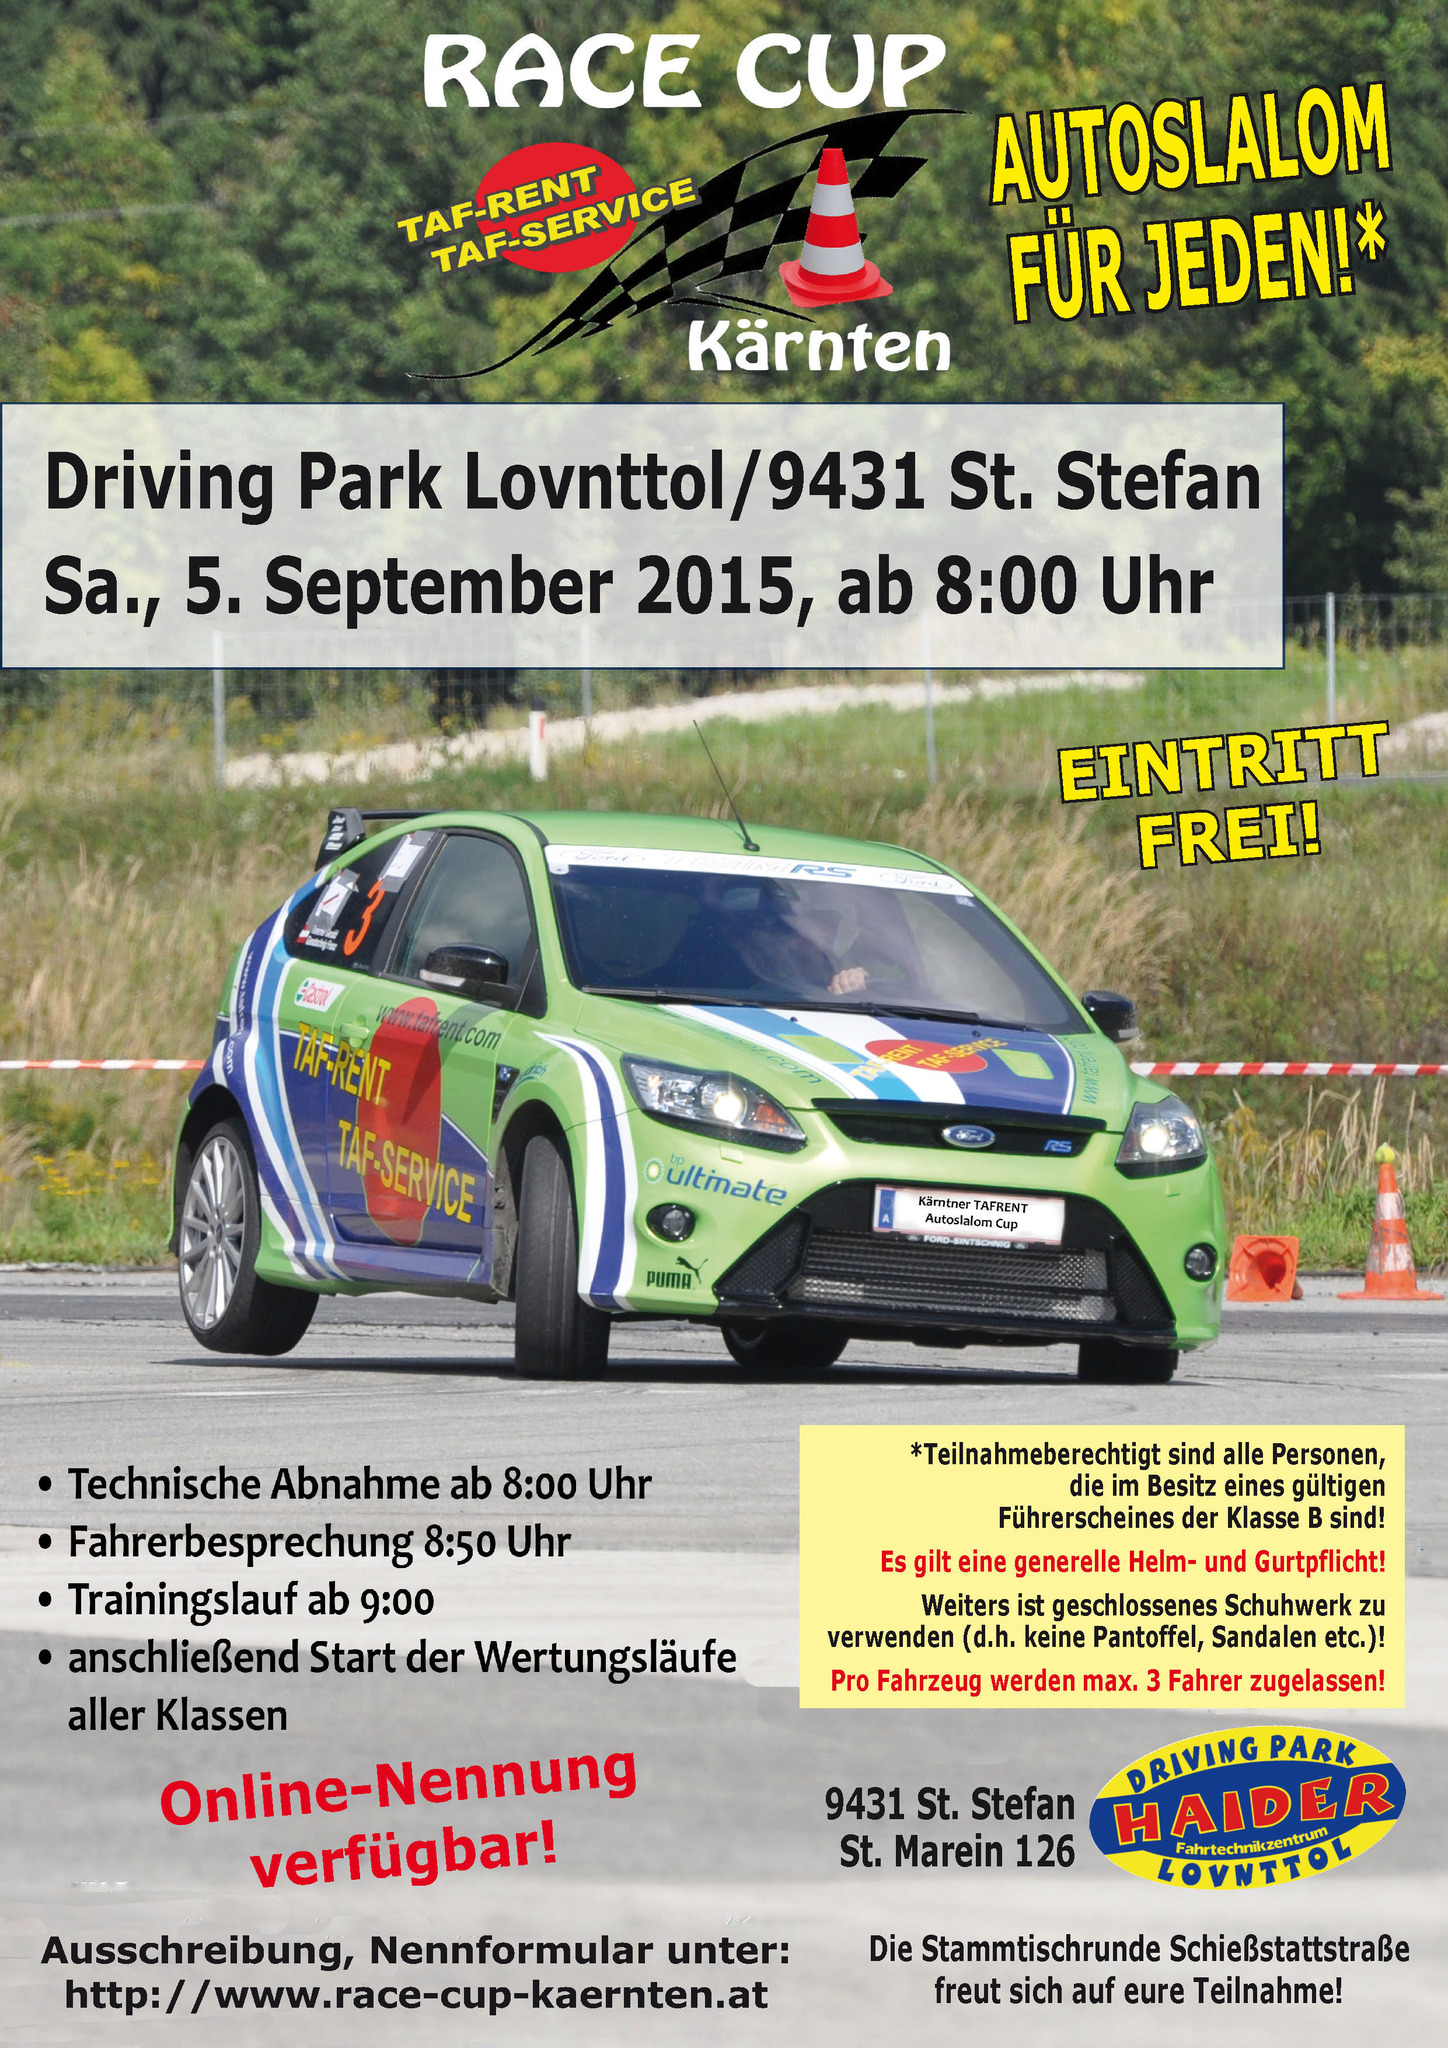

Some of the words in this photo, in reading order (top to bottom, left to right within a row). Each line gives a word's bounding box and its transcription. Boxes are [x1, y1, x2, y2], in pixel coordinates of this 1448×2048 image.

[791, 864, 858, 879] RS
[344, 879, 386, 956] 3
[376, 1005, 502, 1050] www.tafrent.com
[293, 1021, 392, 1106] TAF-RENT
[850, 1044, 924, 1081] TAF-RENT
[1044, 1139, 1072, 1153] RS
[670, 1153, 685, 1167] bp
[338, 1119, 475, 1224] TAF-SERVICE
[666, 1164, 787, 1206] ultimate
[918, 1195, 971, 1210] Kärntner
[974, 1199, 1028, 1214] TAFRENT
[881, 1213, 891, 1224] A
[925, 1212, 993, 1229] Autoslalom
[996, 1218, 1018, 1232] Cup
[923, 1234, 1011, 1250] FORD-SINTSCHNIG
[646, 1270, 692, 1290] PUMA
